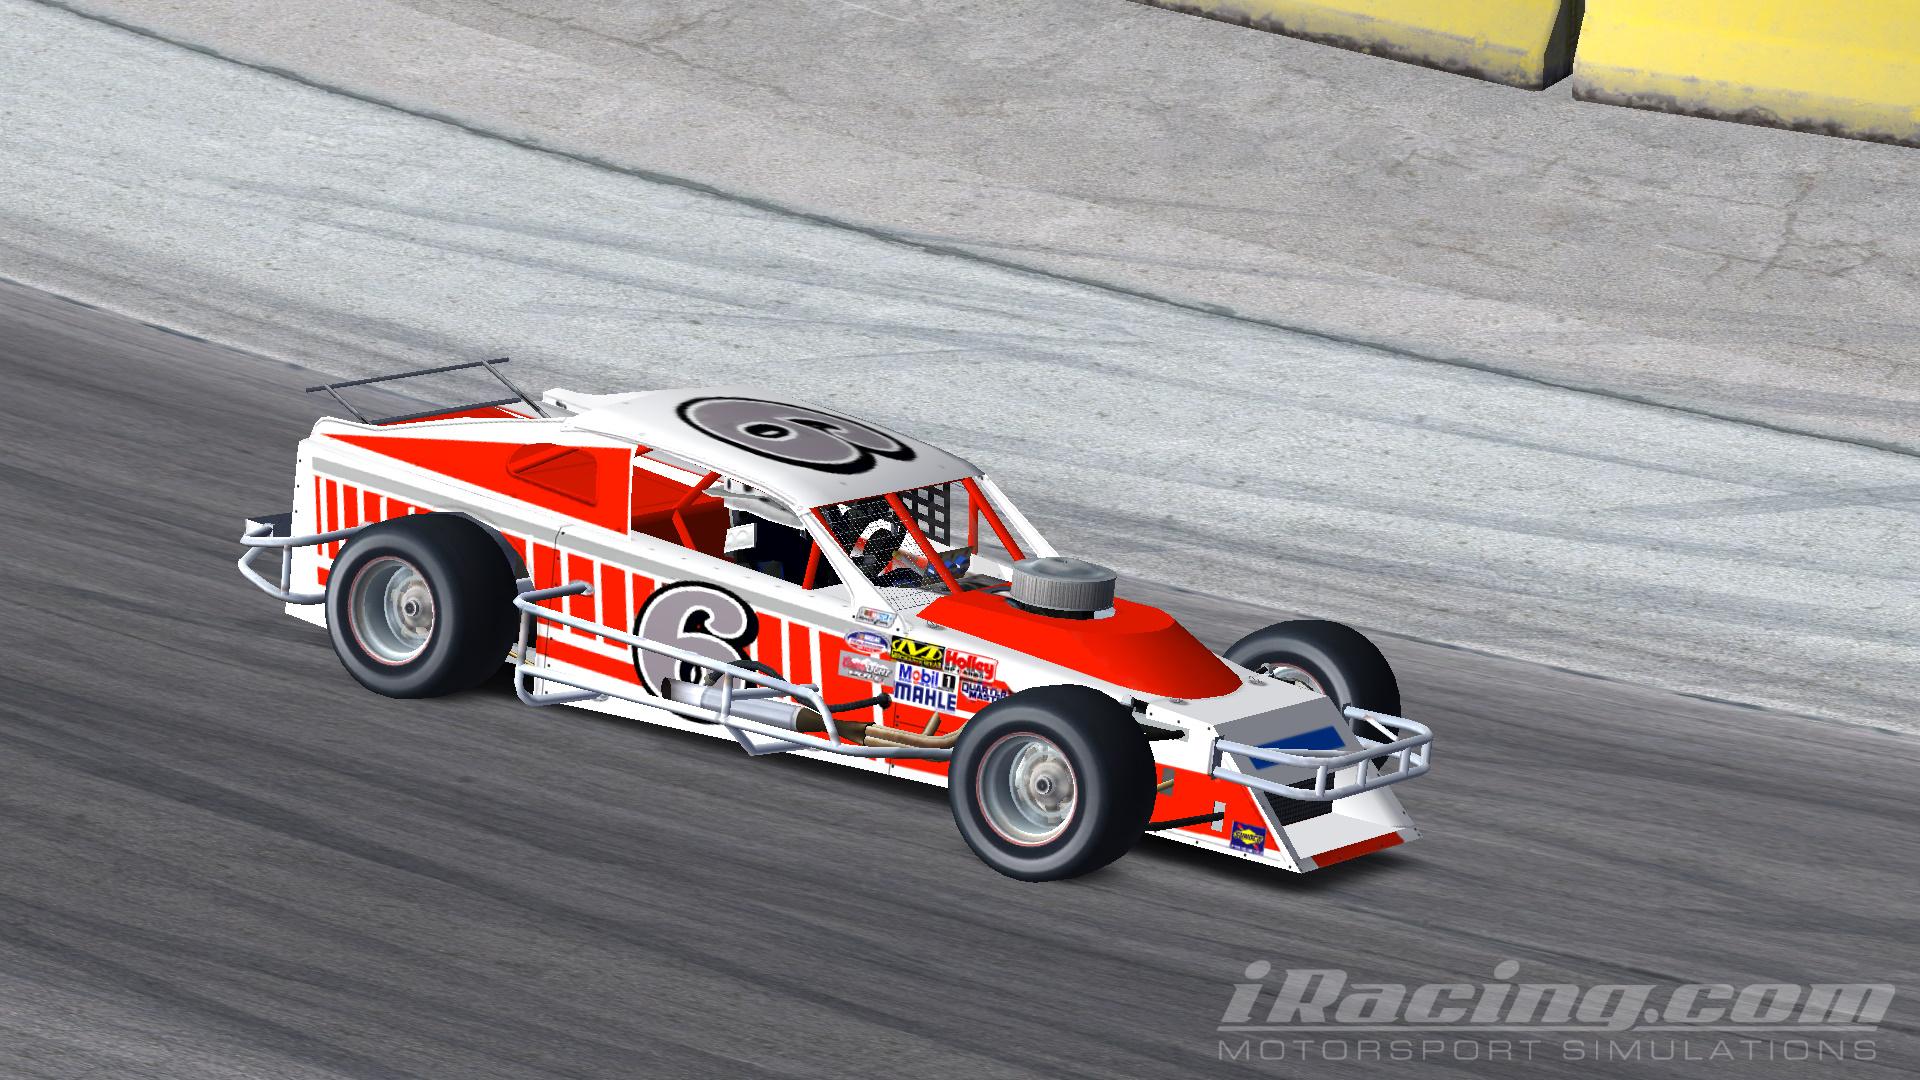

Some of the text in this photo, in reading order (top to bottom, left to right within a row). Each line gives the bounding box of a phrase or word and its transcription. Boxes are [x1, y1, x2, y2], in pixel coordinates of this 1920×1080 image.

[676, 397, 916, 474] 6
[632, 580, 759, 724] 6
[945, 649, 994, 681] Holley
[899, 663, 939, 688] Mobil
[894, 682, 957, 711] MAHLE
